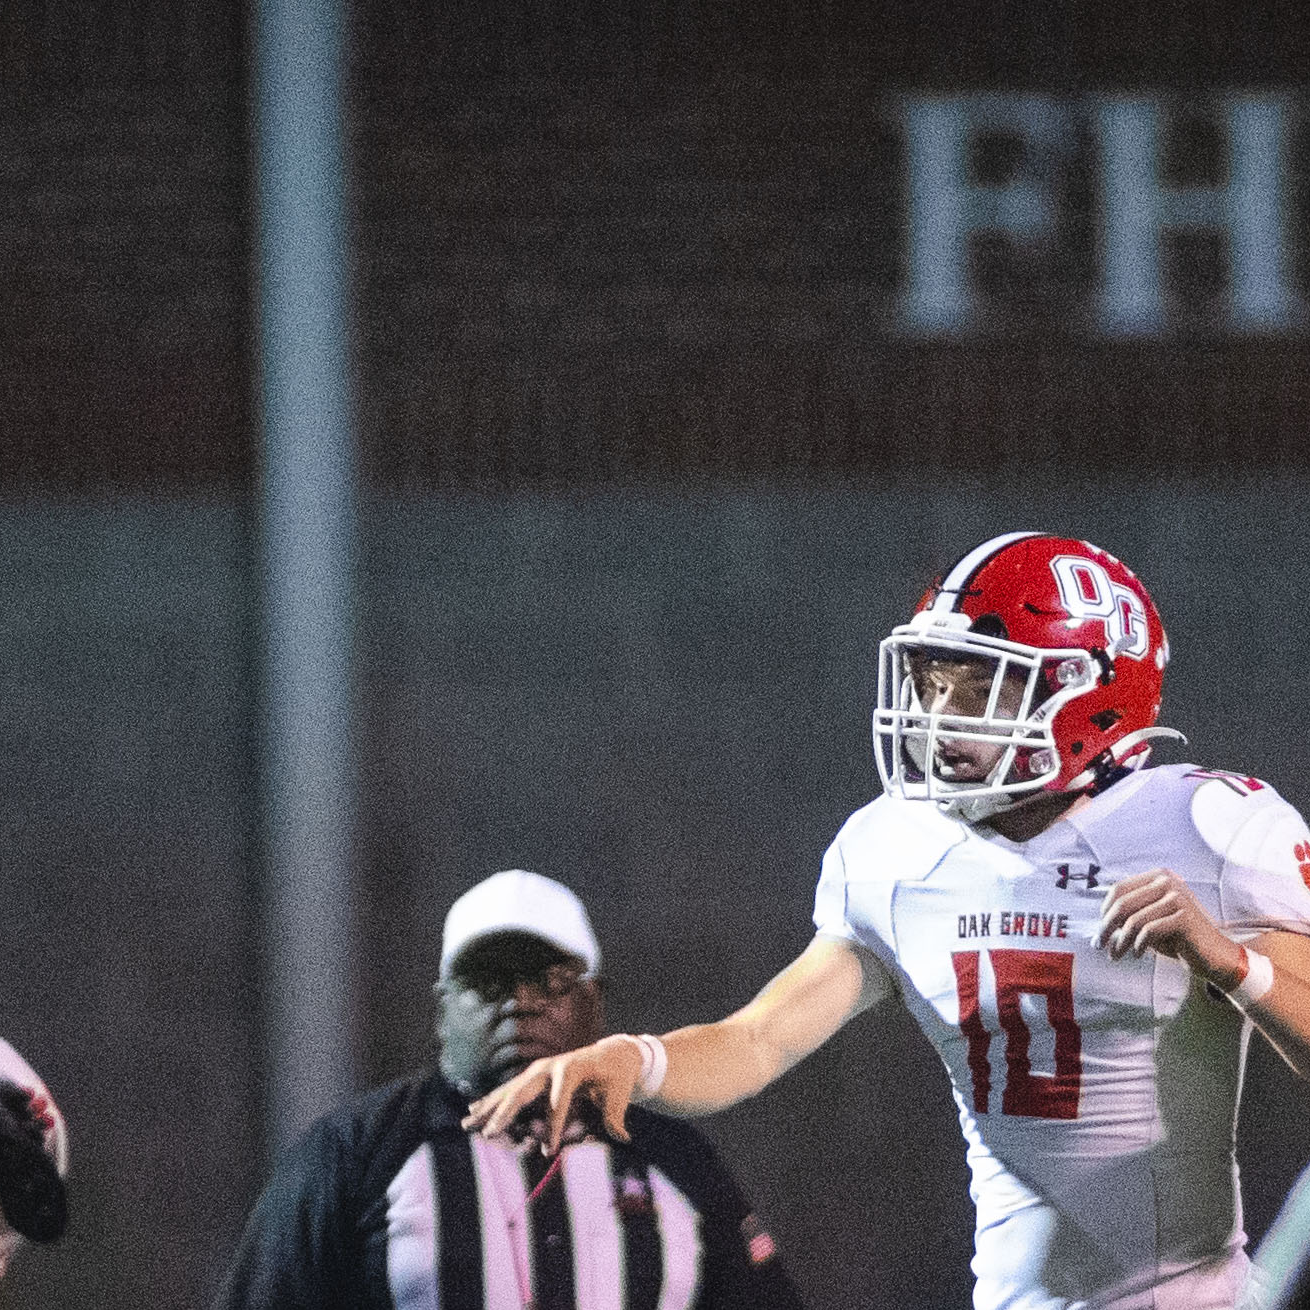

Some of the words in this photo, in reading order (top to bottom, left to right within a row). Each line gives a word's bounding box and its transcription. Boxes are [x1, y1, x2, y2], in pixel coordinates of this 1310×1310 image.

[1049, 554, 1150, 661] OG
[957, 912, 992, 939] OAK
[1000, 911, 1069, 939] GROVE
[951, 949, 1083, 1119] 10
